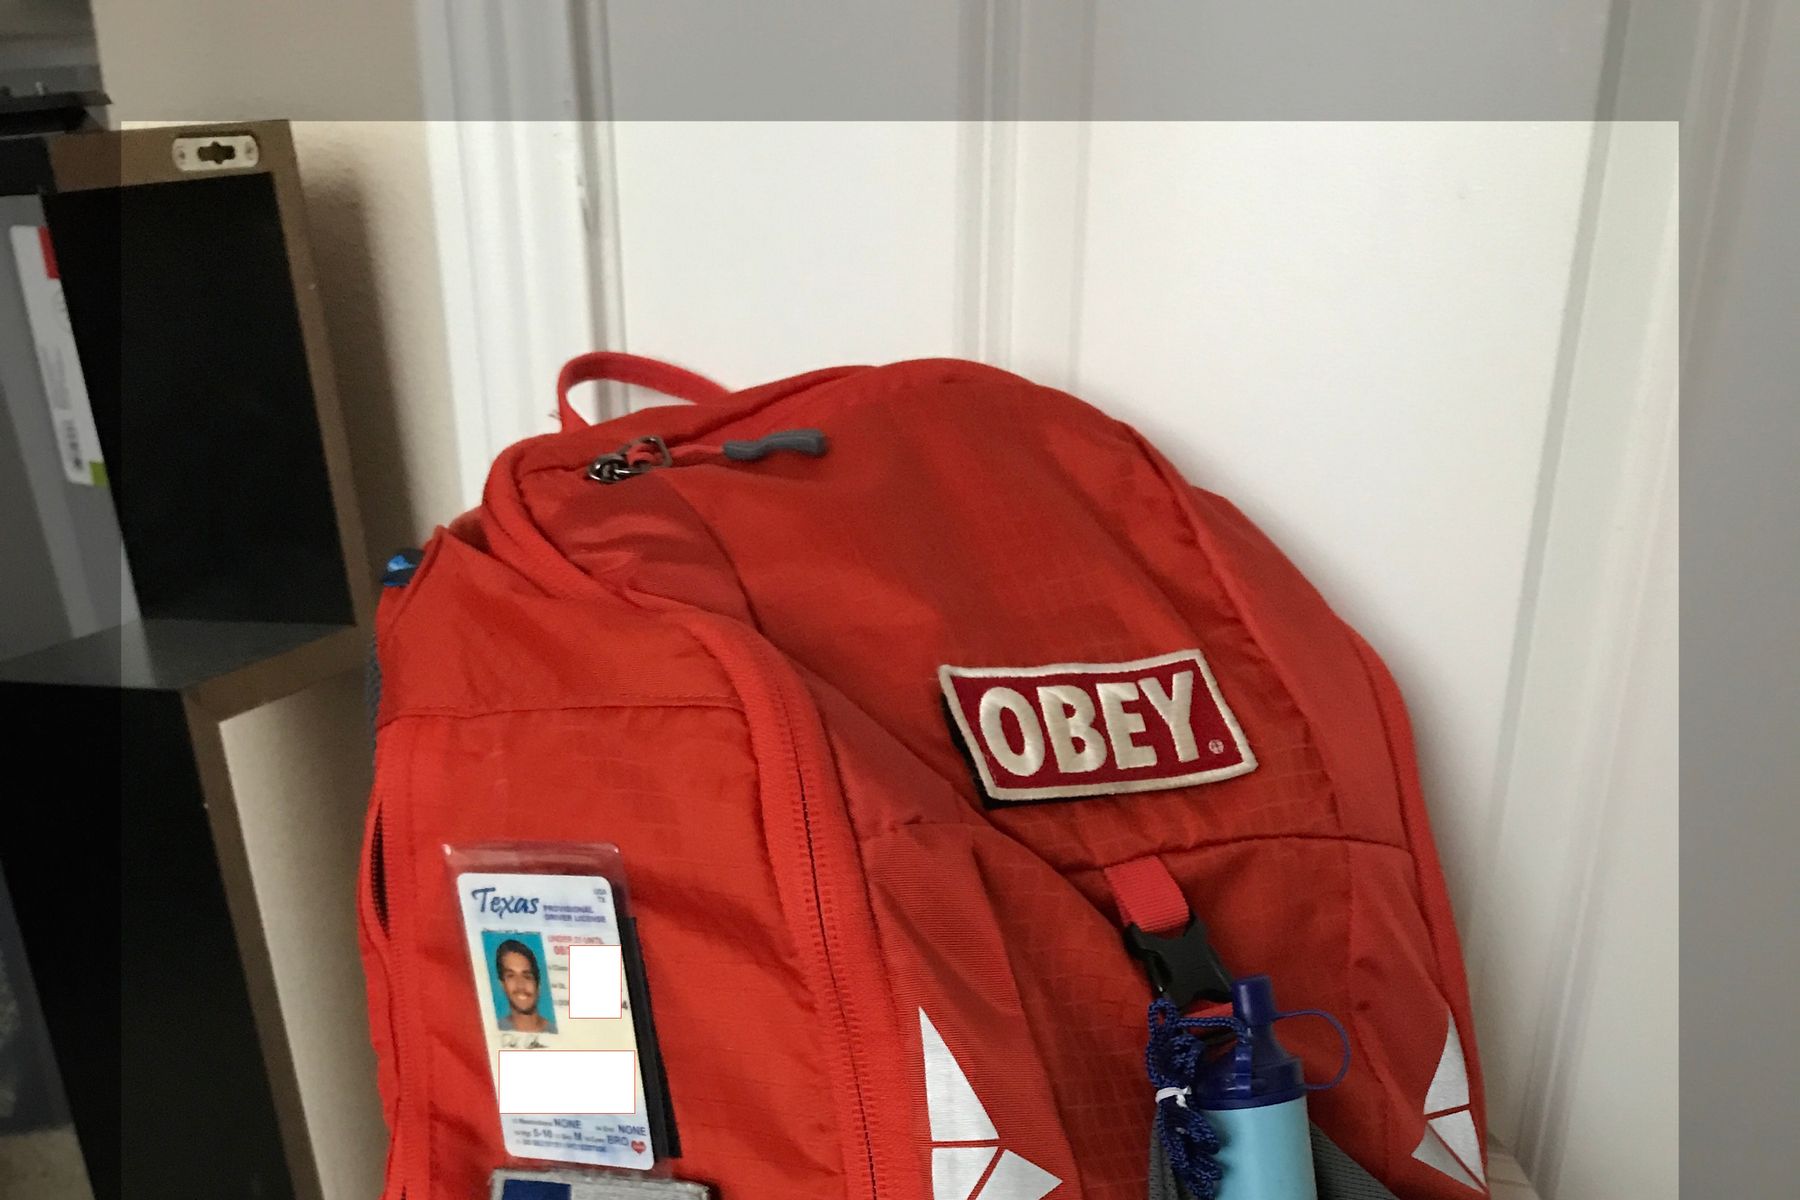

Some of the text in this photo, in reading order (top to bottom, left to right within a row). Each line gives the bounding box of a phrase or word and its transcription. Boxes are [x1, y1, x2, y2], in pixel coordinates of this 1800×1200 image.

[979, 670, 1200, 777] OBEY
[472, 887, 540, 919] Texas
[553, 1118, 581, 1129] NONE
[618, 1125, 646, 1136] NONE
[607, 1135, 629, 1146] BRO
